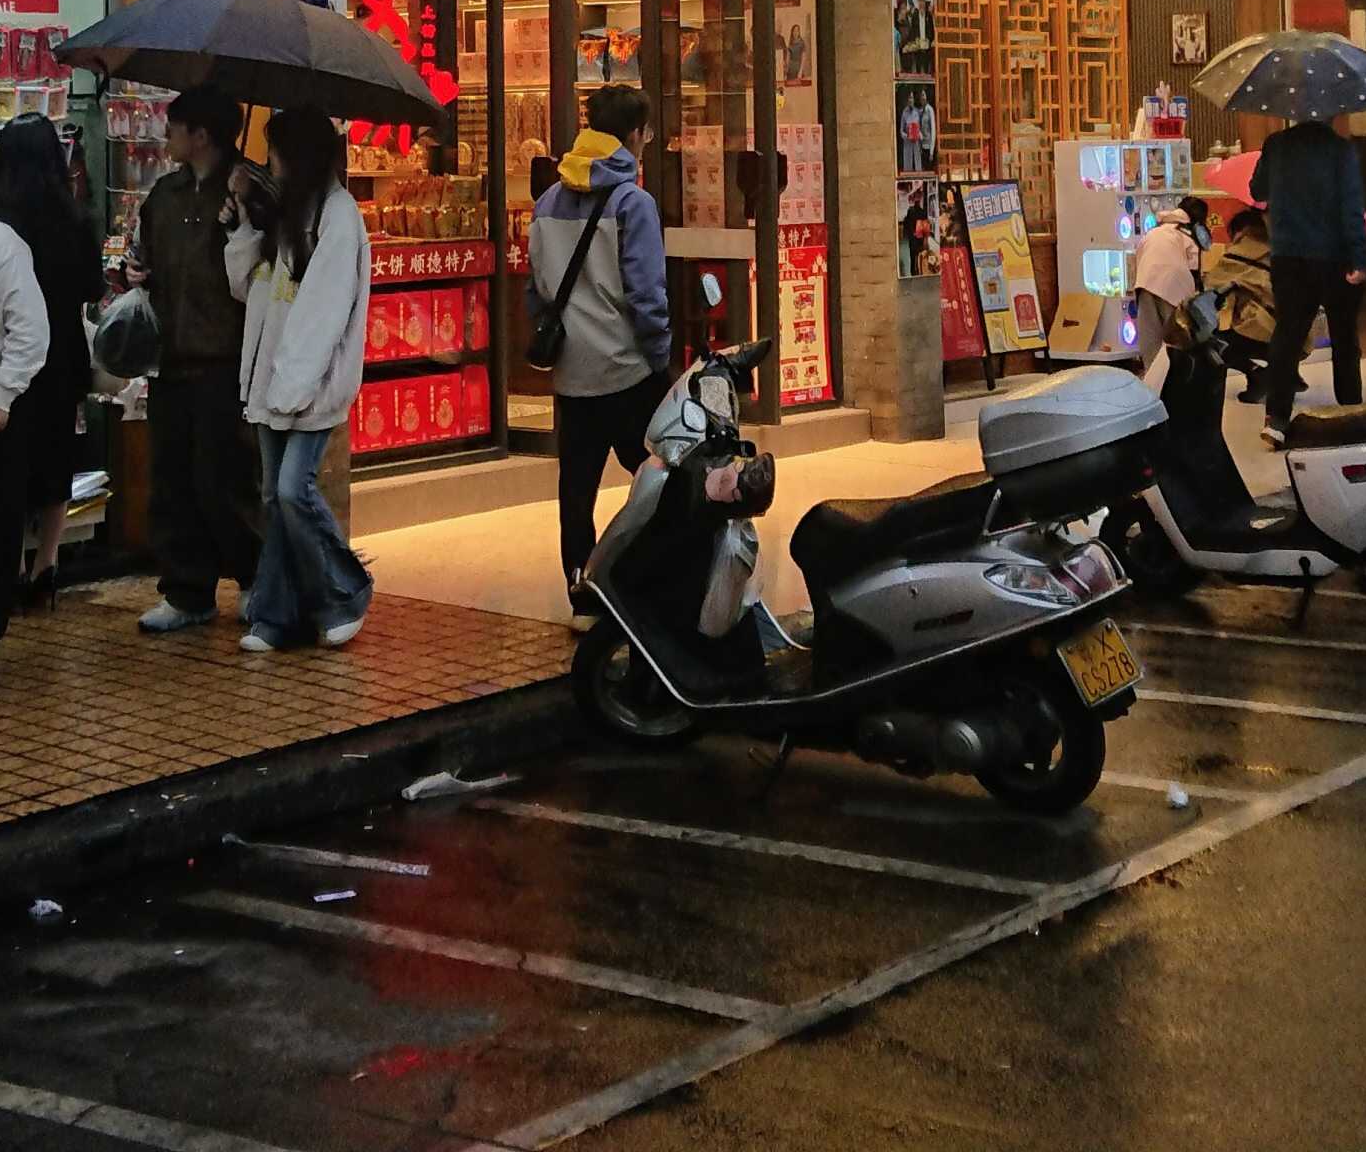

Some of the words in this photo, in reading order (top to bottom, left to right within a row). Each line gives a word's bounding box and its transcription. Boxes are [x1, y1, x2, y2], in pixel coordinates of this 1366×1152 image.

[409, 249, 476, 275] 顺德特产
[1081, 651, 1135, 697] CS278
